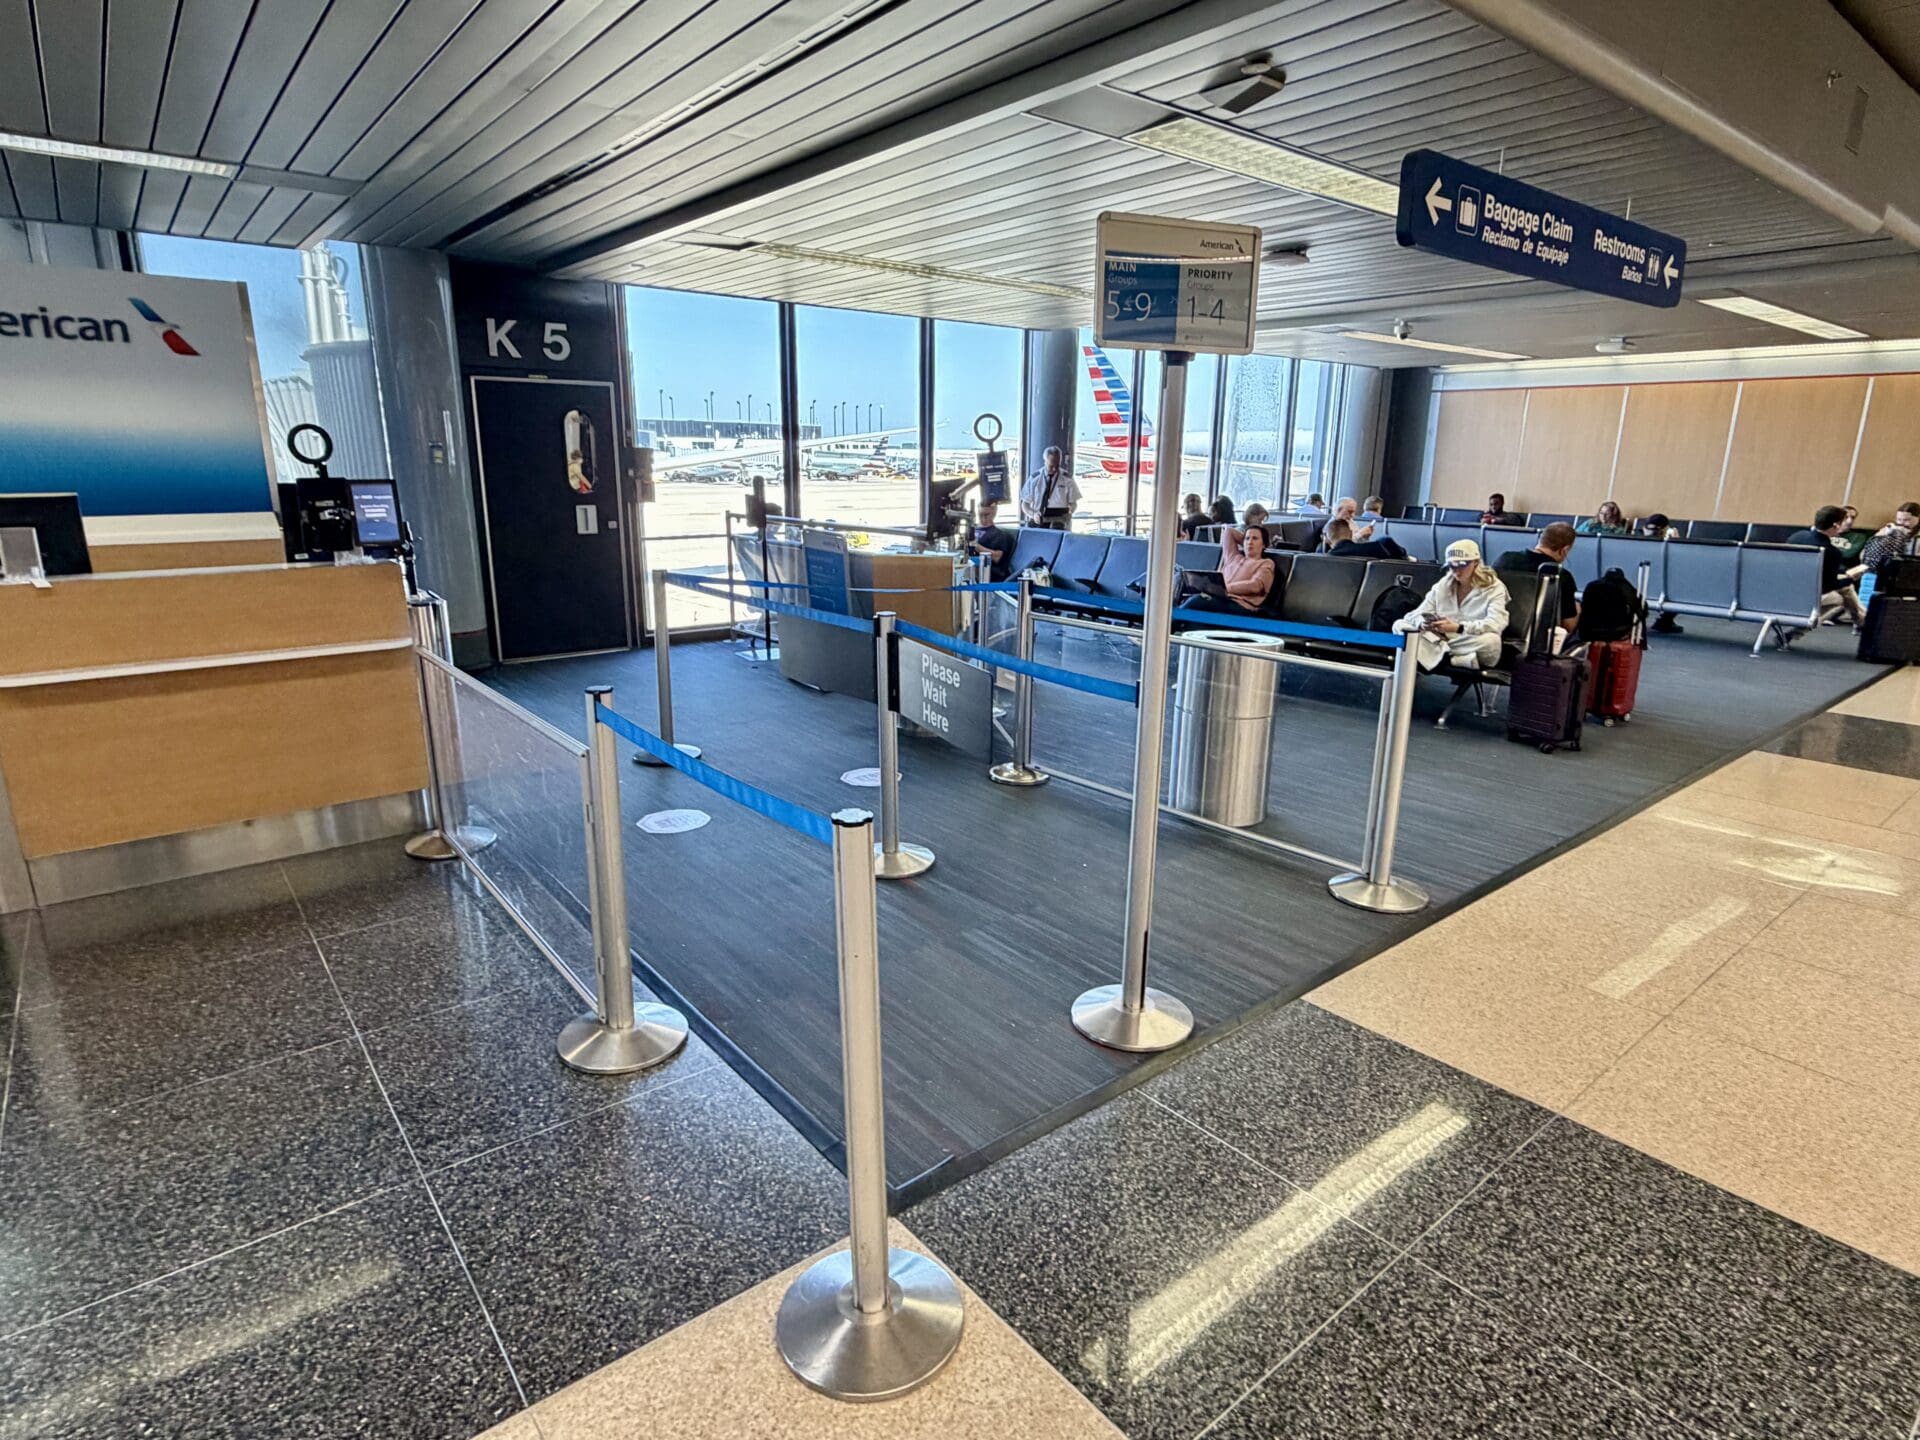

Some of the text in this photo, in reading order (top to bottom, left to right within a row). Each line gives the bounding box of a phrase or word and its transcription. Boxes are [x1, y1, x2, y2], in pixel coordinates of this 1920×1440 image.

[1484, 193, 1573, 243] Baggage Claim
[1200, 239, 1234, 251] American
[1481, 225, 1569, 266] Reclamo de Equipaje
[1593, 228, 1646, 264] Restrooms
[1108, 260, 1137, 273] MAIN
[1108, 273, 1137, 287] Groups
[1187, 268, 1233, 280] PRIORITY
[1621, 265, 1643, 283] Baños
[486, 317, 571, 361] K 5
[921, 652, 961, 688] Please
[921, 677, 948, 708] Wait
[922, 701, 949, 732] Here
